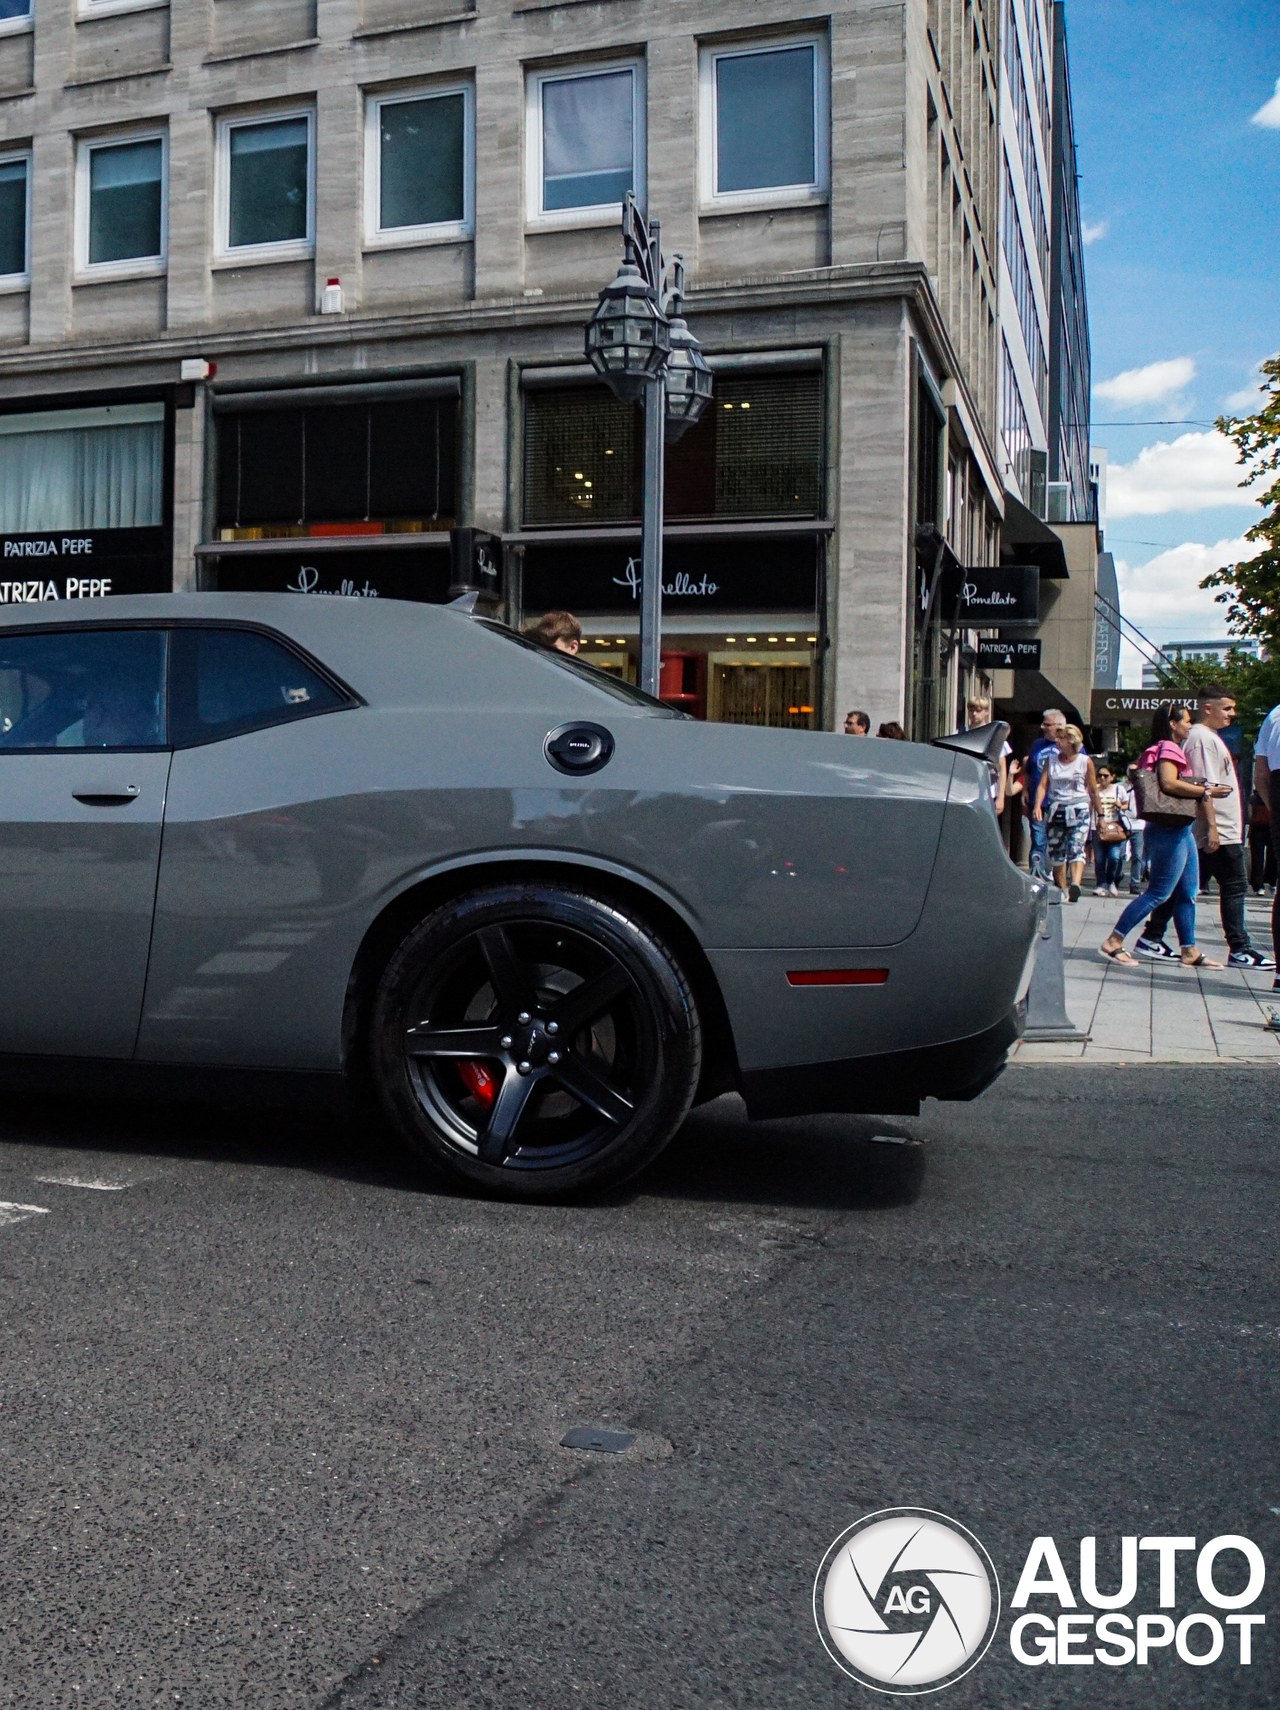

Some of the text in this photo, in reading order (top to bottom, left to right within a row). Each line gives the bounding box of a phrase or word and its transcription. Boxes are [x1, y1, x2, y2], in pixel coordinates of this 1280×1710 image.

[4, 538, 93, 557] PATRIZIA PEPE
[961, 582, 1018, 607] Pomellato
[980, 643, 1038, 654] PATRIZIA PEPE
